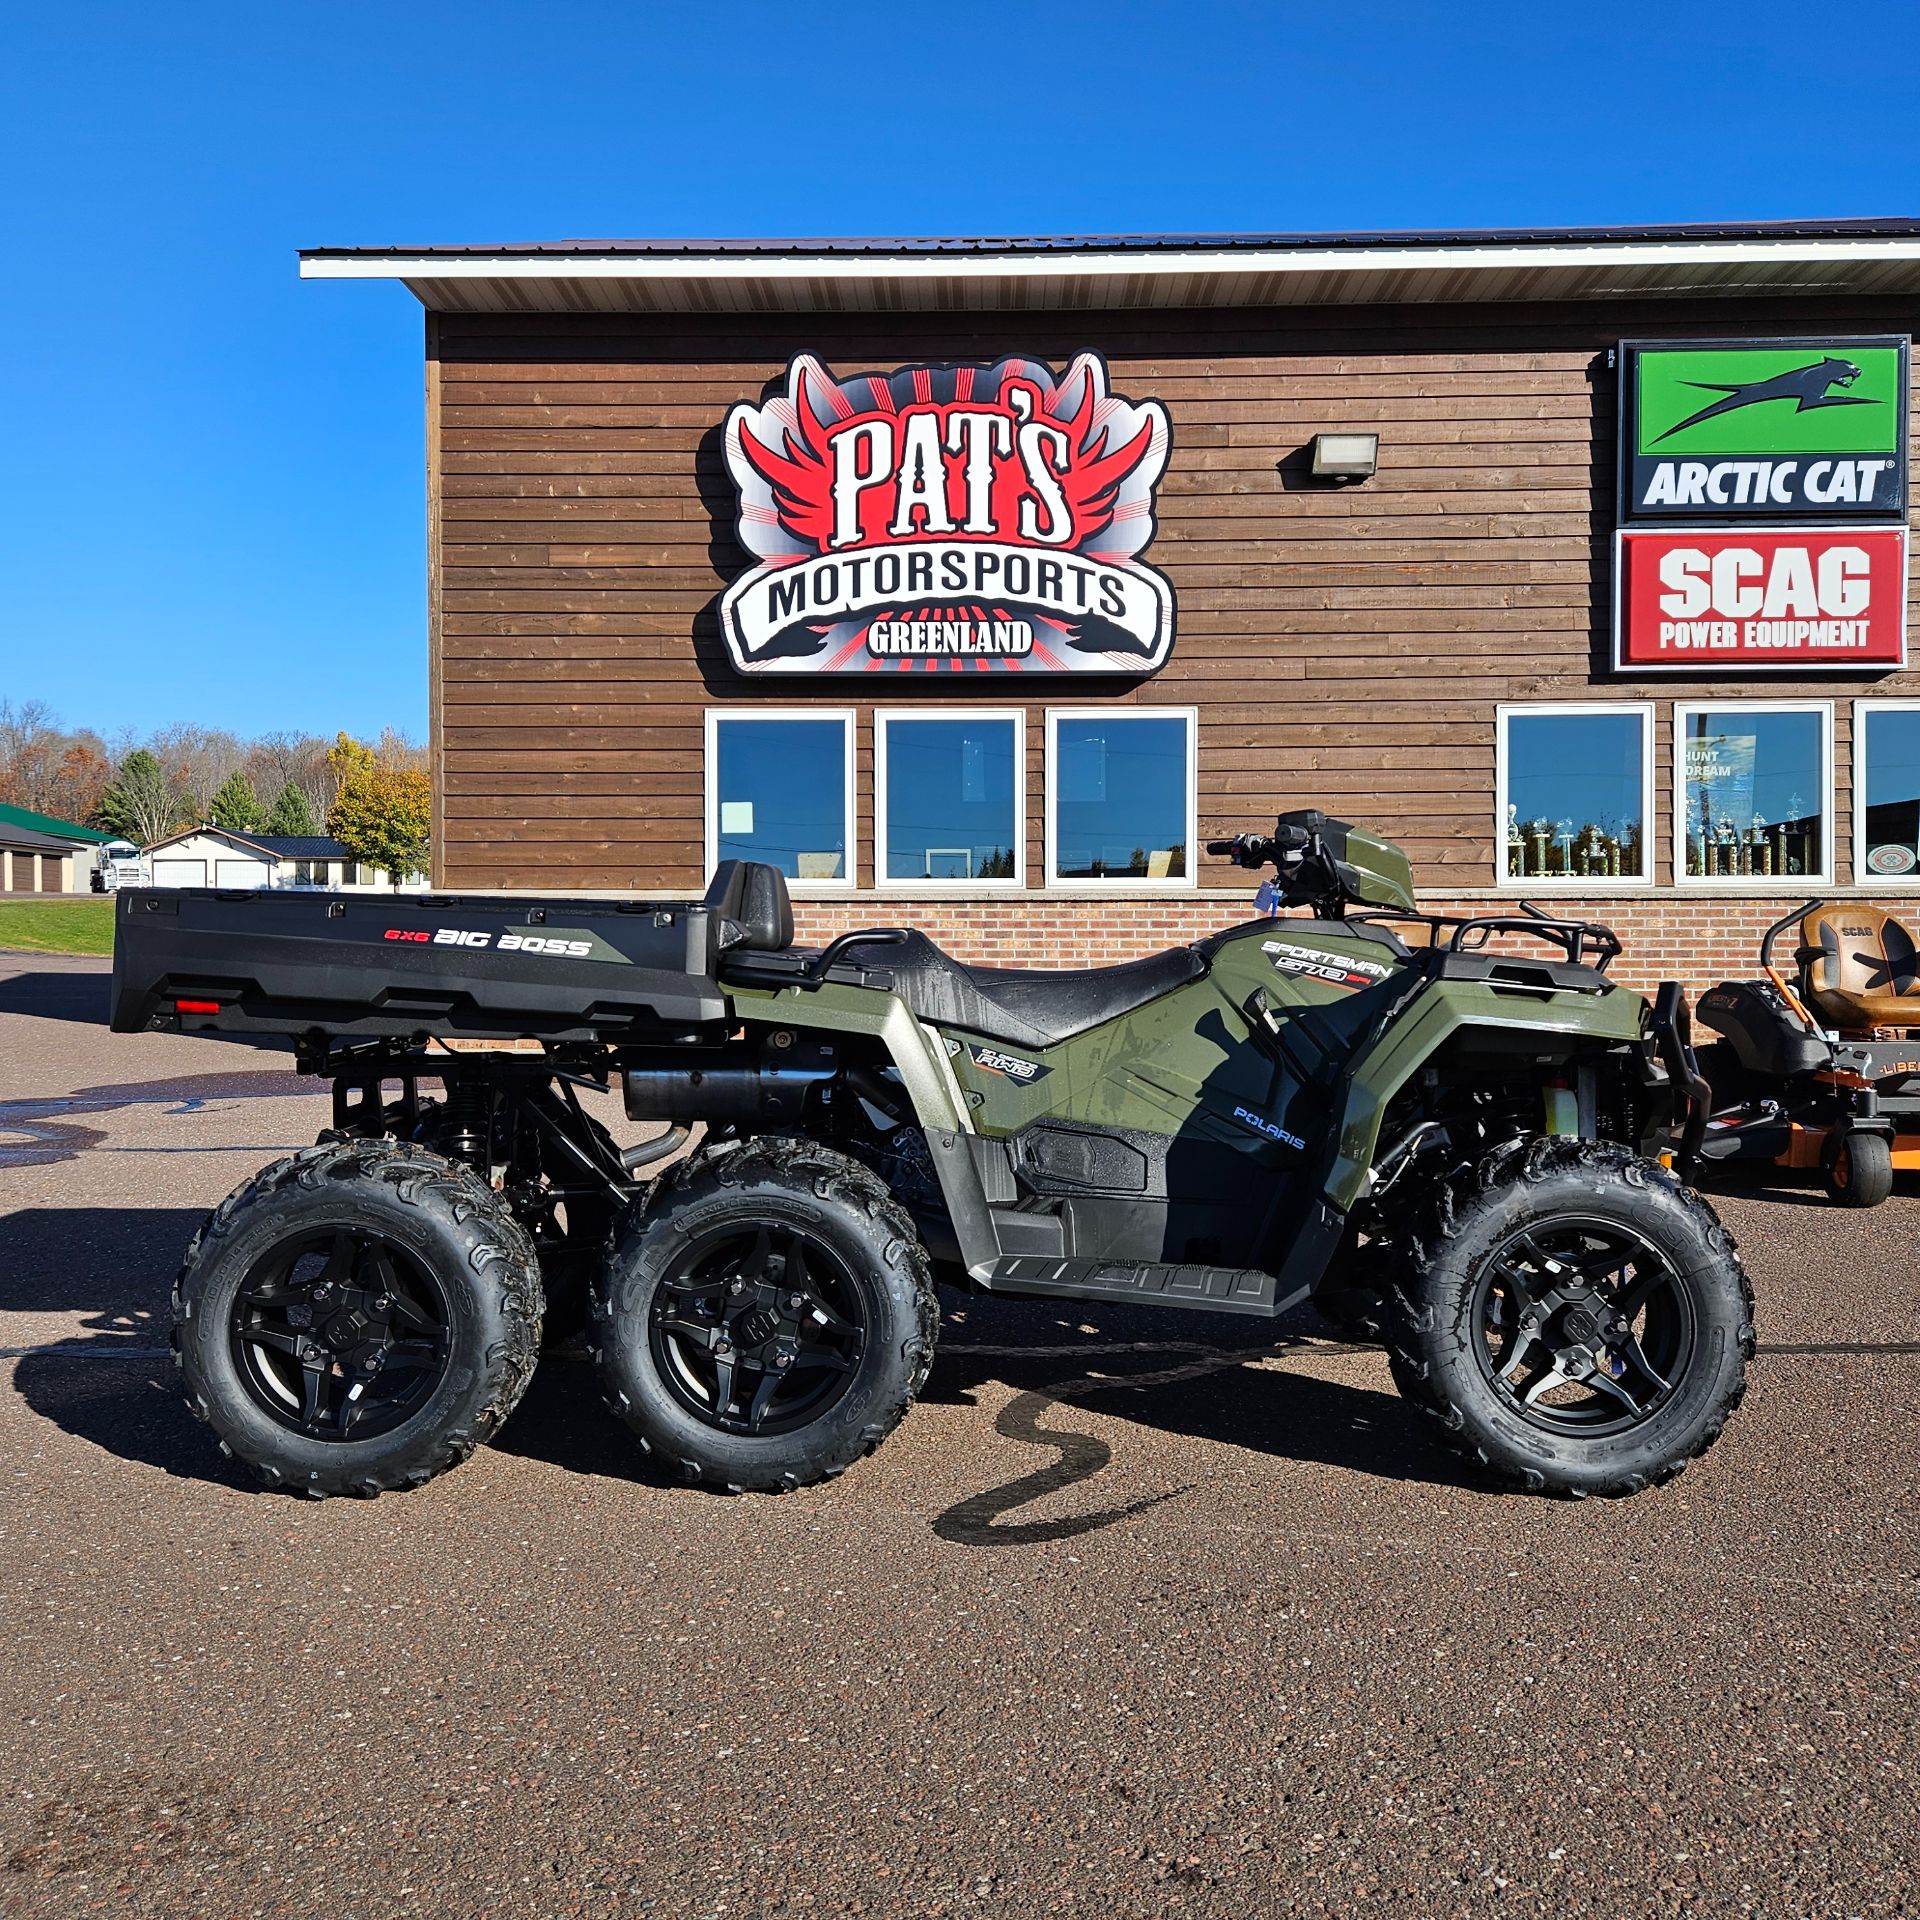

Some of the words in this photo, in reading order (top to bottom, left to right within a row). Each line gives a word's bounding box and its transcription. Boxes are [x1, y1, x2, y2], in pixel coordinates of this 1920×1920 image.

[829, 387, 1072, 548] PAT'S
[1642, 461, 1797, 505] ARCTIC
[768, 550, 1127, 622] MOTORSPORTS
[1659, 547, 1871, 618] SCAG
[868, 621, 1033, 654] GREENLAND
[1659, 621, 1738, 649] POWER
[1743, 620, 1871, 647] EQUIPMENT
[1686, 765, 1731, 777] DREAM
[433, 928, 491, 947] BIG
[497, 934, 593, 956] BOSS
[1841, 926, 1873, 937] SCAG
[1260, 940, 1394, 978] SPORTSMAN
[1274, 956, 1347, 982] 570
[975, 1053, 1035, 1077] AWD
[1883, 1061, 1920, 1075] LIBE
[1233, 1106, 1306, 1150] POLARIS
